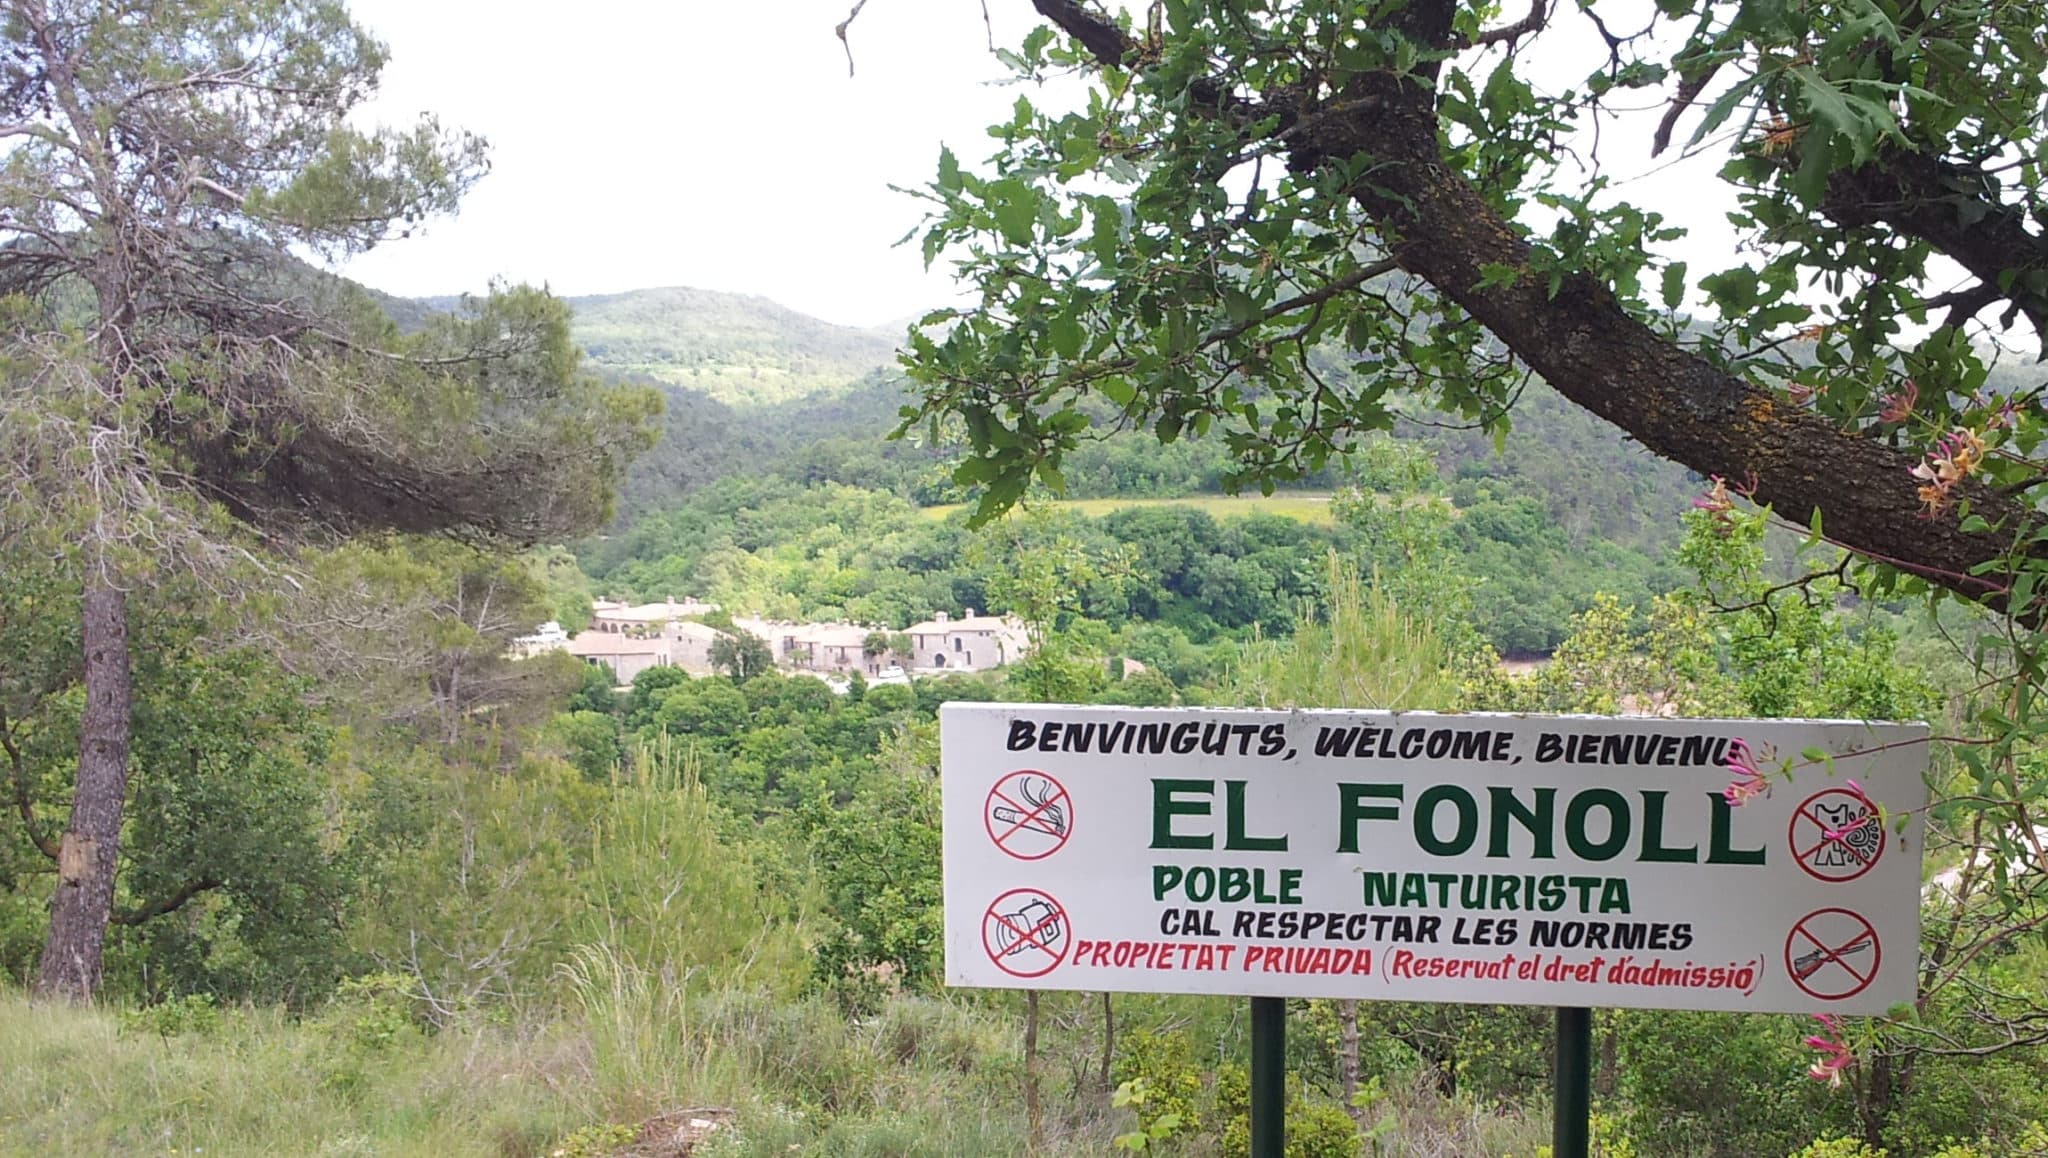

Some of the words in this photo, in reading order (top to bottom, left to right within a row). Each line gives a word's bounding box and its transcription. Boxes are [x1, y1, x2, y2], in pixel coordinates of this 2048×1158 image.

[1007, 720, 1297, 760] BENVINGUTS,
[1314, 726, 1522, 765] WELCOME,
[1148, 778, 1289, 853] EL
[1337, 783, 1767, 866] FONOLL
[1152, 865, 1303, 905] POBLE
[1363, 871, 1632, 914] NATURISTA
[1160, 908, 1221, 937] CAL
[1233, 911, 1442, 944] RESPECTAR
[1452, 916, 1518, 946] LES
[1529, 921, 1693, 950] NORMES
[1072, 940, 1236, 970] PROPIETAT
[1243, 946, 1371, 975] PRIVADA
[1382, 945, 1515, 984] (Reservat
[1518, 954, 1541, 980] el
[1543, 955, 1605, 984] dret
